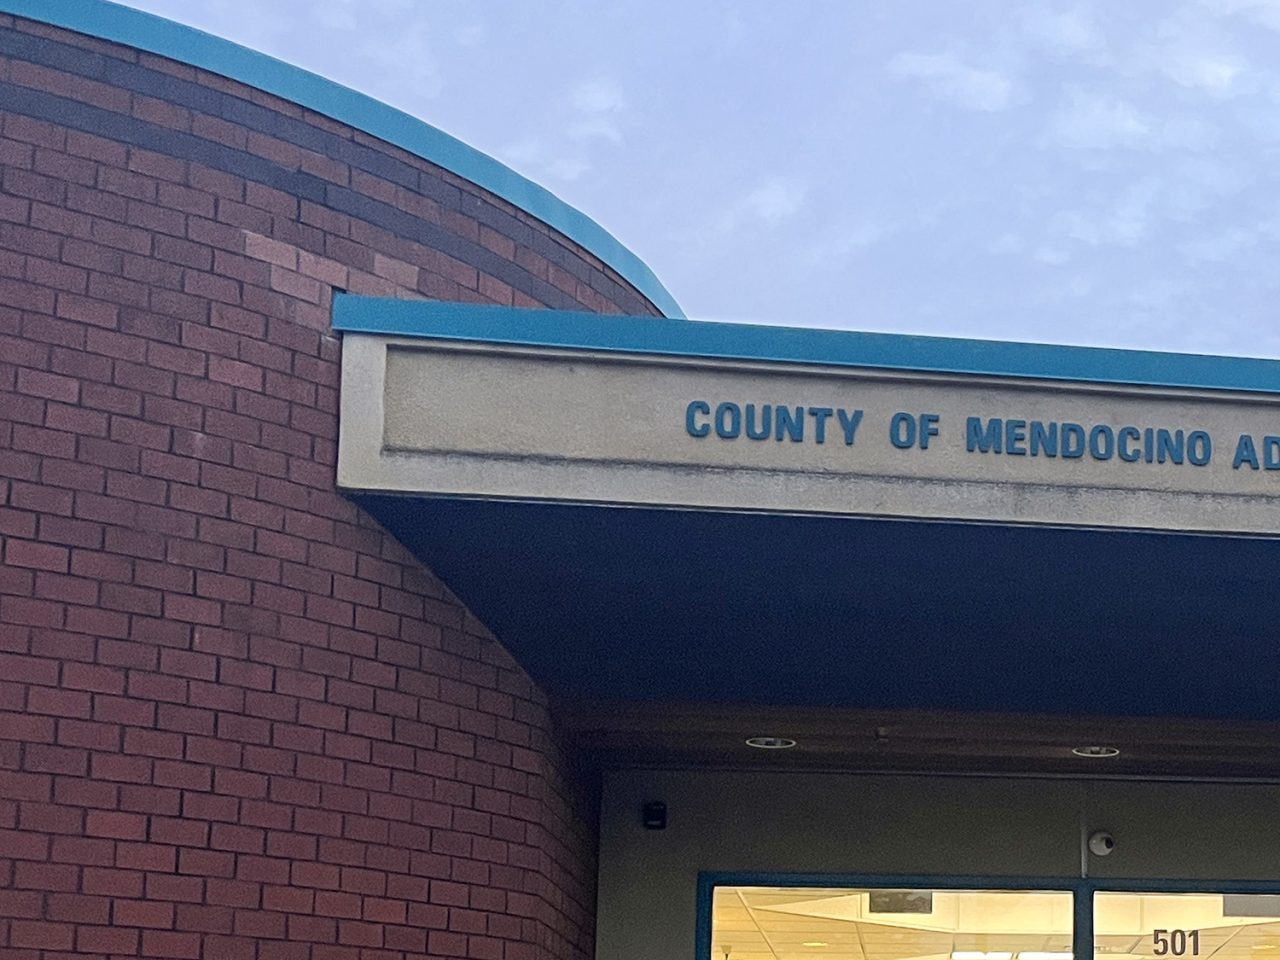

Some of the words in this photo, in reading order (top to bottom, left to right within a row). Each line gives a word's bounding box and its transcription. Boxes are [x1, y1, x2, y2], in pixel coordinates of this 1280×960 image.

[685, 400, 864, 445] COUNTY
[889, 411, 940, 449] OF
[966, 416, 1212, 467] MENDOCINO
[1153, 929, 1199, 956] 501
